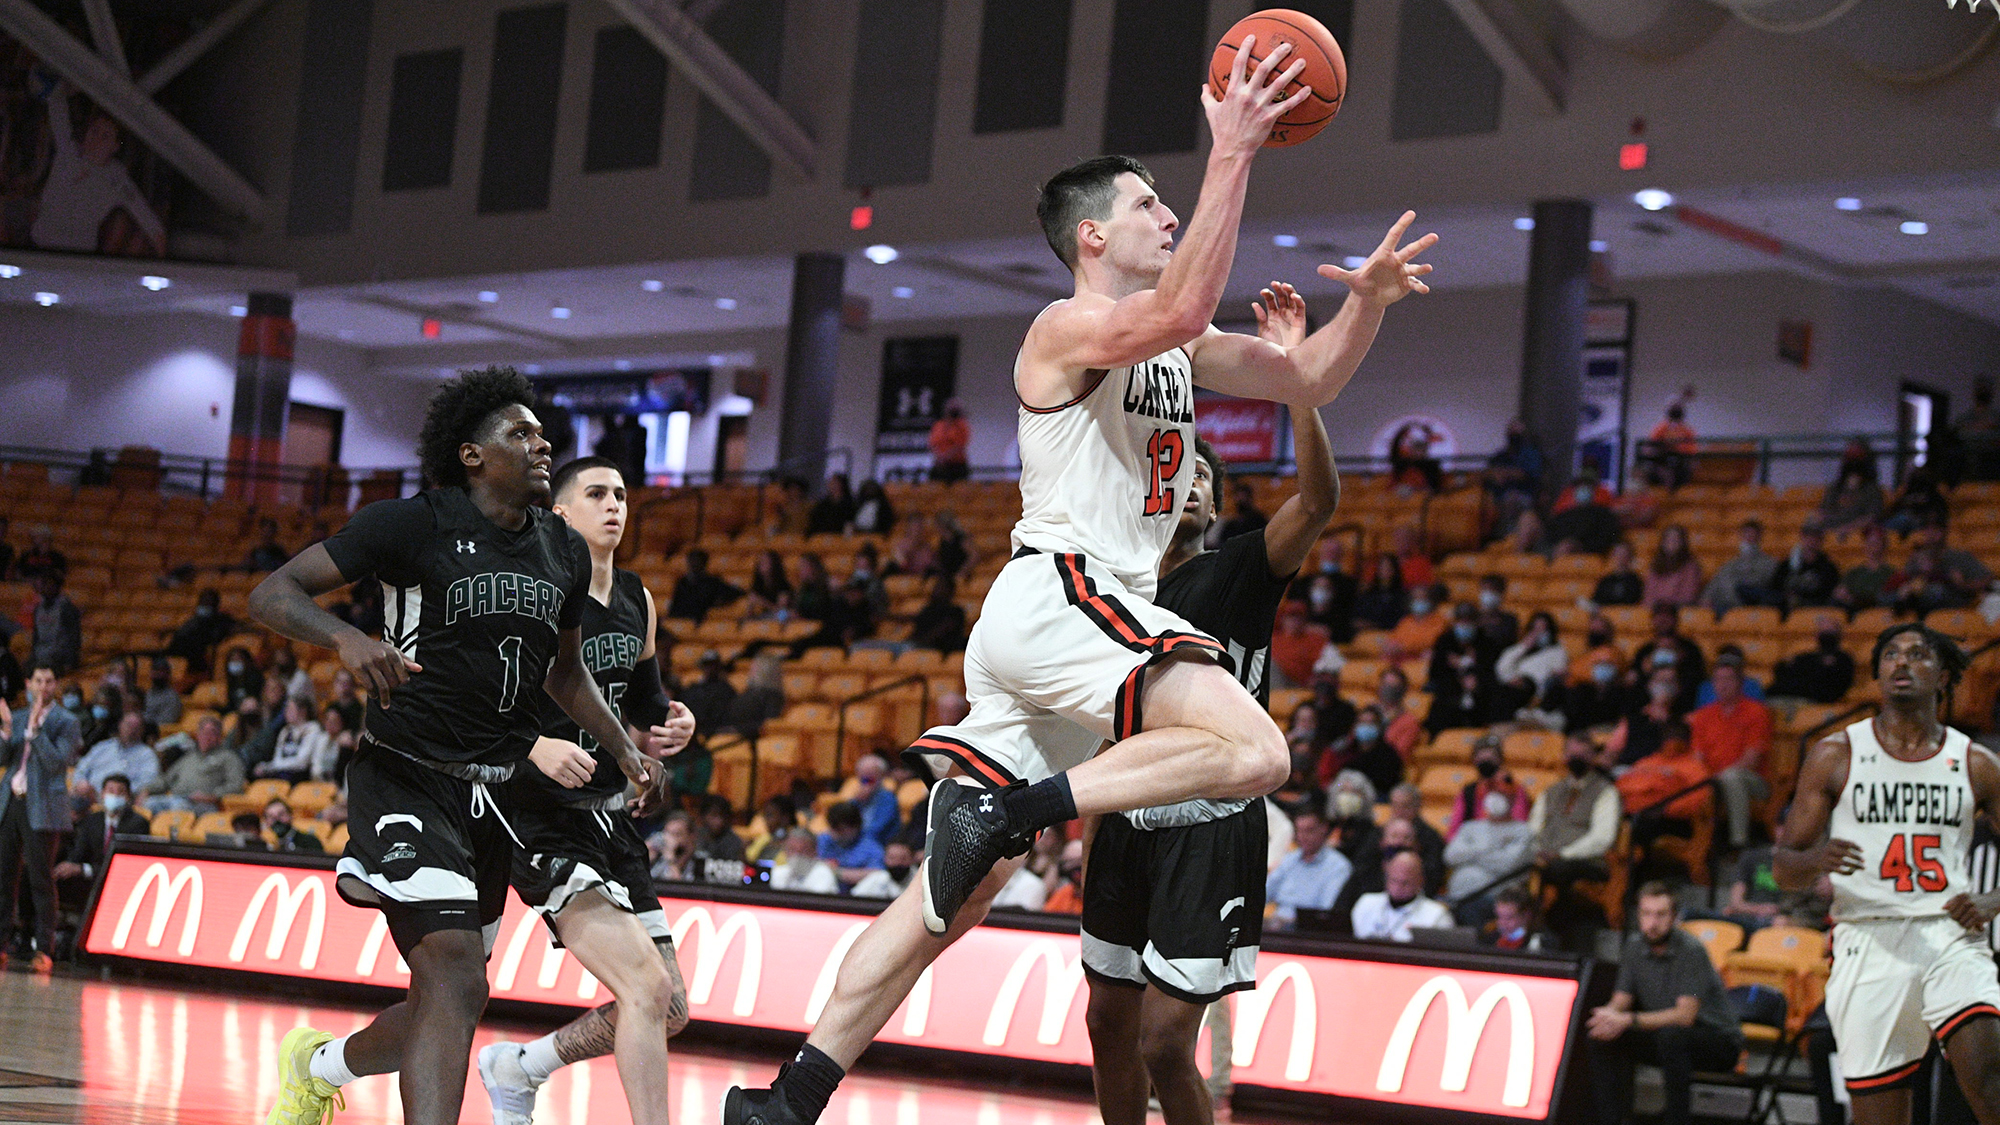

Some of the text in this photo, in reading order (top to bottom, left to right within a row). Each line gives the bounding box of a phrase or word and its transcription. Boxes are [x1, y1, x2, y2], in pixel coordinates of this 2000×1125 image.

[1142, 428, 1184, 517] 12
[498, 635, 523, 713] 1
[580, 632, 645, 674] ACER
[1852, 782, 1963, 828] CAMPBELL
[1880, 833, 1949, 893] 45
